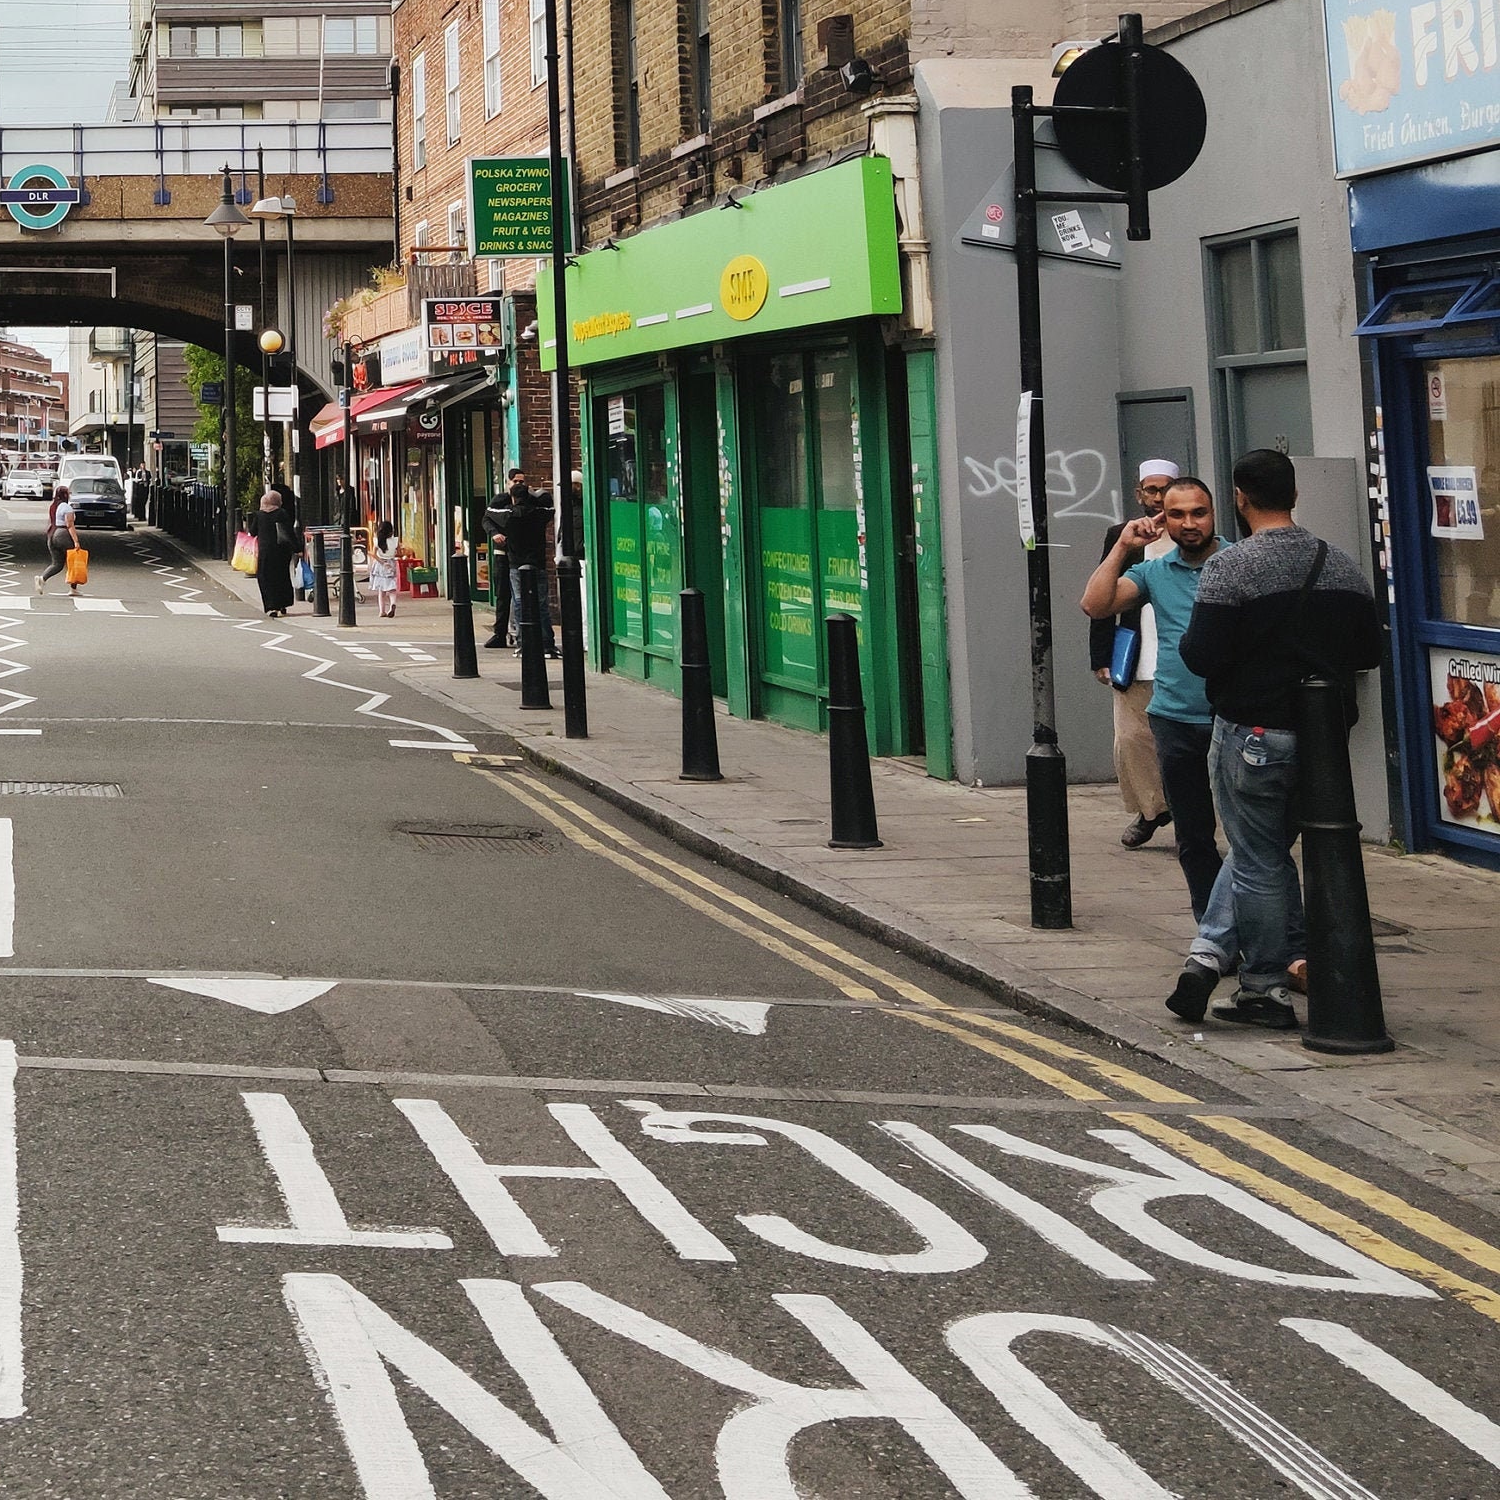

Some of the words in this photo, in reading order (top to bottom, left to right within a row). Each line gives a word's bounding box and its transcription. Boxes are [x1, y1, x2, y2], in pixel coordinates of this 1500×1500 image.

[1363, 122, 1394, 151] Fried
[1460, 100, 1500, 132] Burge
[475, 168, 513, 178] POLSKA
[515, 165, 551, 178] ŻYWNO
[496, 183, 542, 192] GROCERY
[29, 192, 49, 201] DLR
[488, 197, 552, 207] NEWSPAPERS
[493, 211, 548, 221] MAGAZINES
[493, 226, 520, 236] FRUIT
[522, 226, 528, 235] &
[532, 226, 551, 235] VEG
[479, 241, 515, 250] DRINKS
[517, 241, 524, 250] &
[526, 241, 553, 250] SNAC
[434, 302, 493, 315] SPICE
[762, 550, 810, 572] CONFECTIONER
[1448, 658, 1482, 681] Grilled
[215, 1090, 1440, 1301] RIGHT
